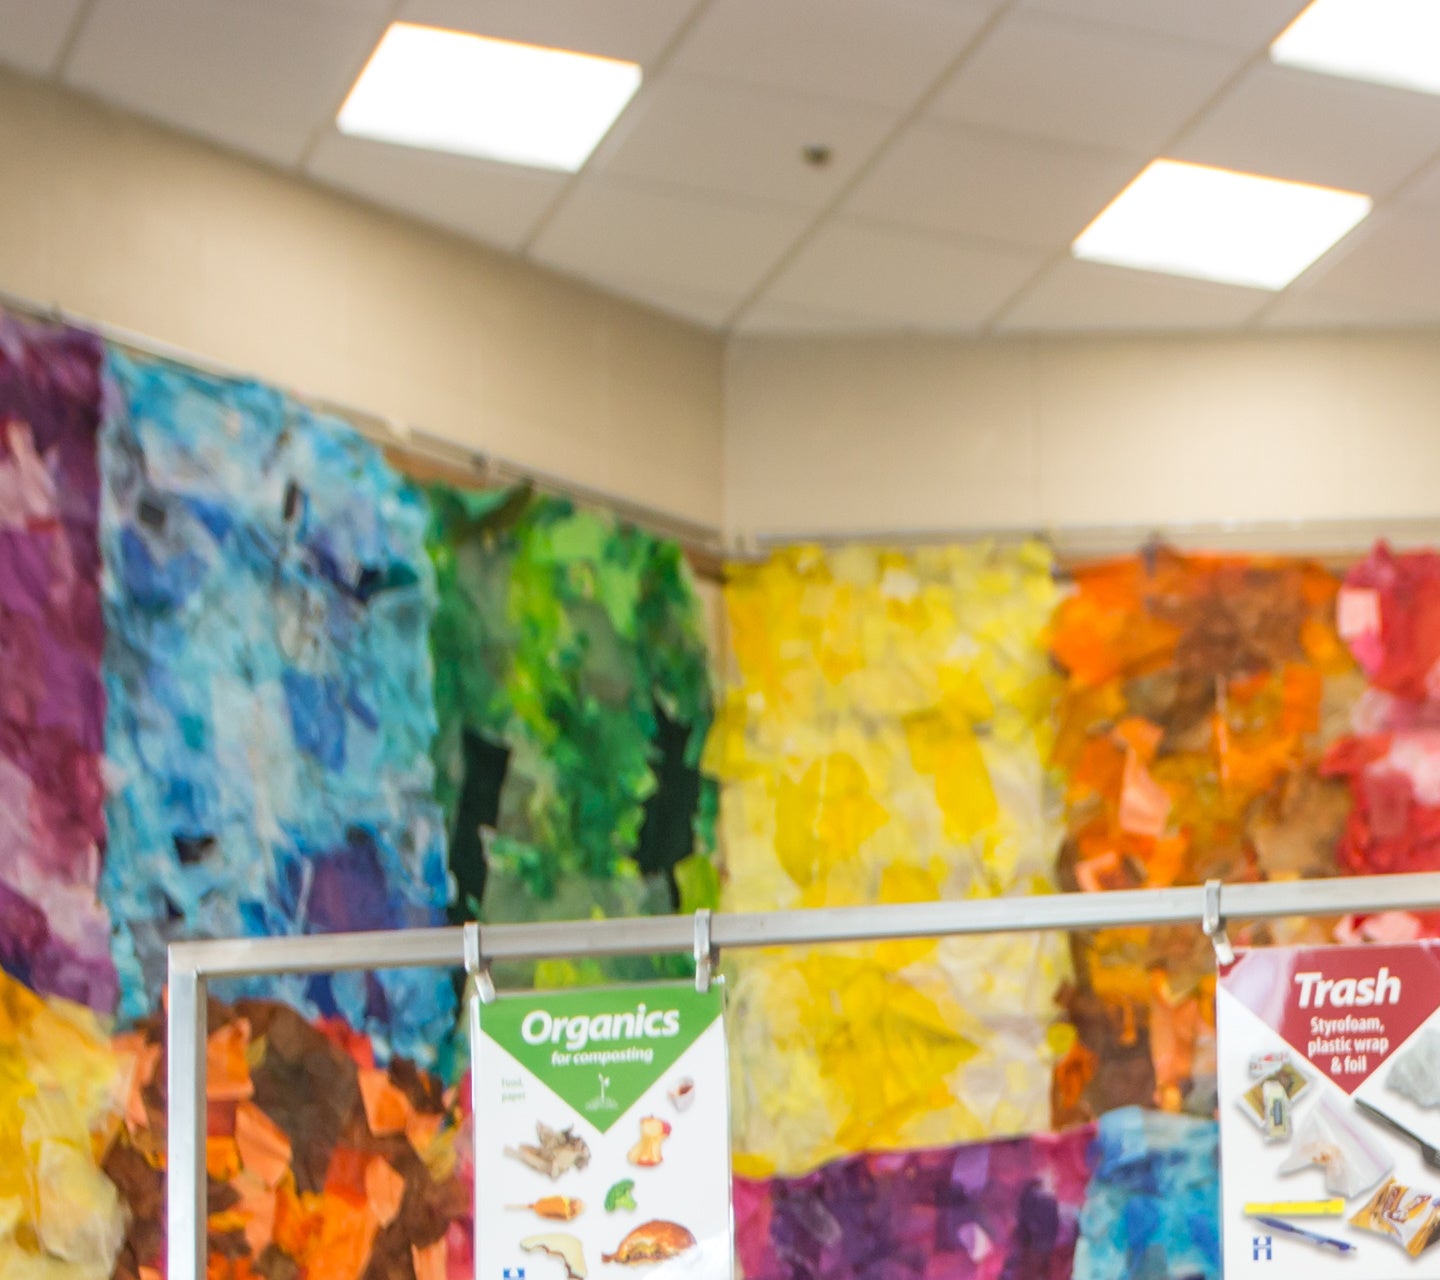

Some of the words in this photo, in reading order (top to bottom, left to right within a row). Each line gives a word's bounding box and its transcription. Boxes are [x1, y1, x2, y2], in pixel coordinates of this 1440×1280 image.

[1294, 967, 1401, 1008] Trash
[521, 1003, 680, 1051] Organics
[1310, 1014, 1385, 1036] Styrofoam,
[551, 1049, 571, 1067] for
[573, 1046, 654, 1067] composting
[1308, 1037, 1352, 1059] plastic
[1353, 1038, 1389, 1056] wrap
[1330, 1057, 1342, 1074] &
[1344, 1055, 1367, 1073] foil
